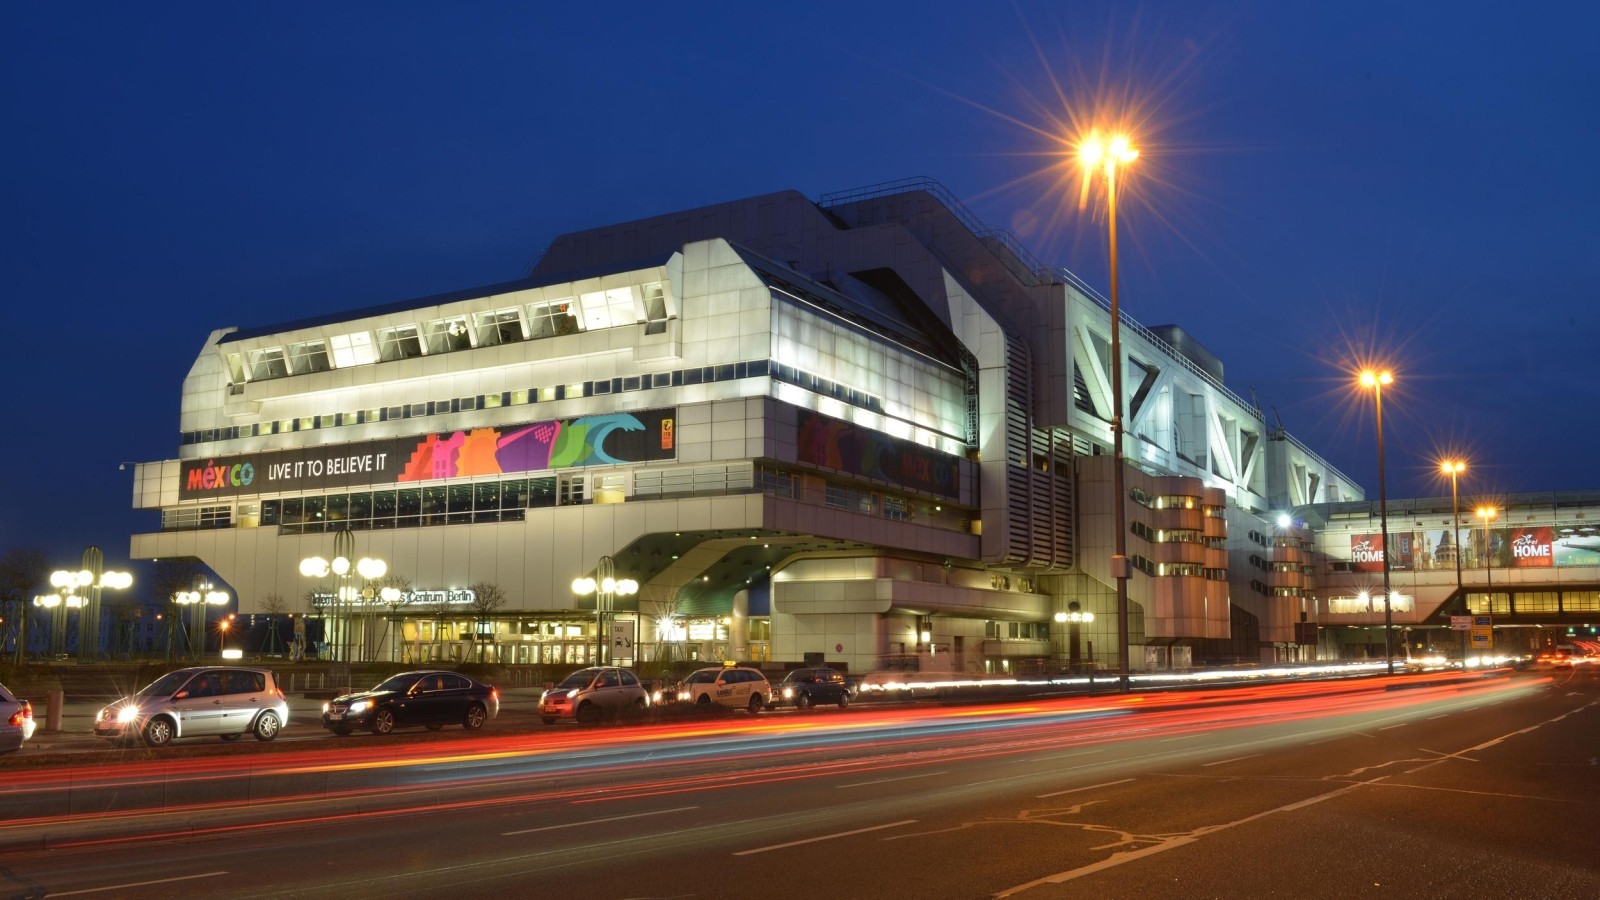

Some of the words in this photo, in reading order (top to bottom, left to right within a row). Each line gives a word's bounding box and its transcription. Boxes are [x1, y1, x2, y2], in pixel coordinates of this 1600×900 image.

[268, 462, 291, 480] LIVE
[294, 461, 304, 478] IT
[307, 460, 323, 477] TO
[326, 454, 372, 476] BELIEVE
[376, 454, 386, 470] IT
[1353, 550, 1384, 562] HOME
[1514, 544, 1550, 557] HOME
[410, 591, 444, 603] Centrum
[448, 590, 472, 602] Berlin
